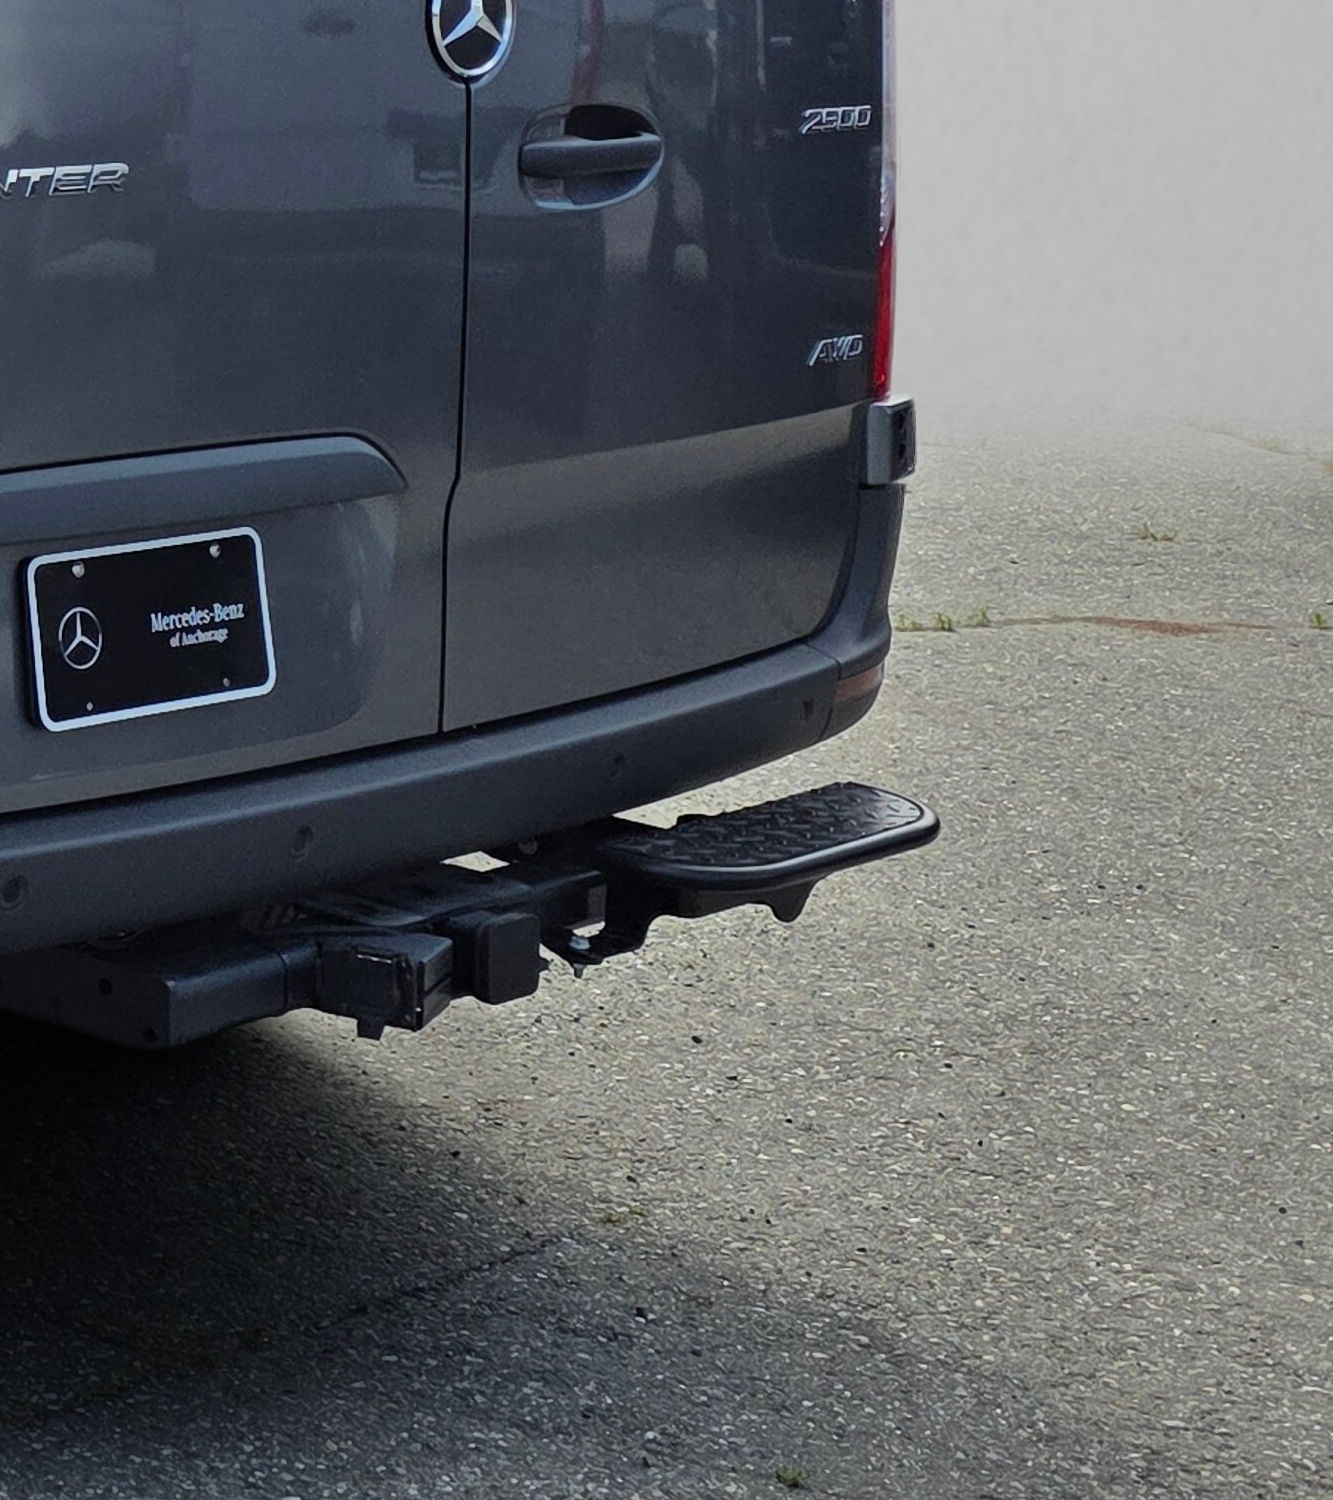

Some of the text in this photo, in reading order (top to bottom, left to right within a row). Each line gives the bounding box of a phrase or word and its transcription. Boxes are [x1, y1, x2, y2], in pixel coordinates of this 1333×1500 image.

[800, 104, 872, 134] 2500
[150, 603, 244, 632] Mercedes-Benz
[169, 628, 228, 648] of Anchorage
